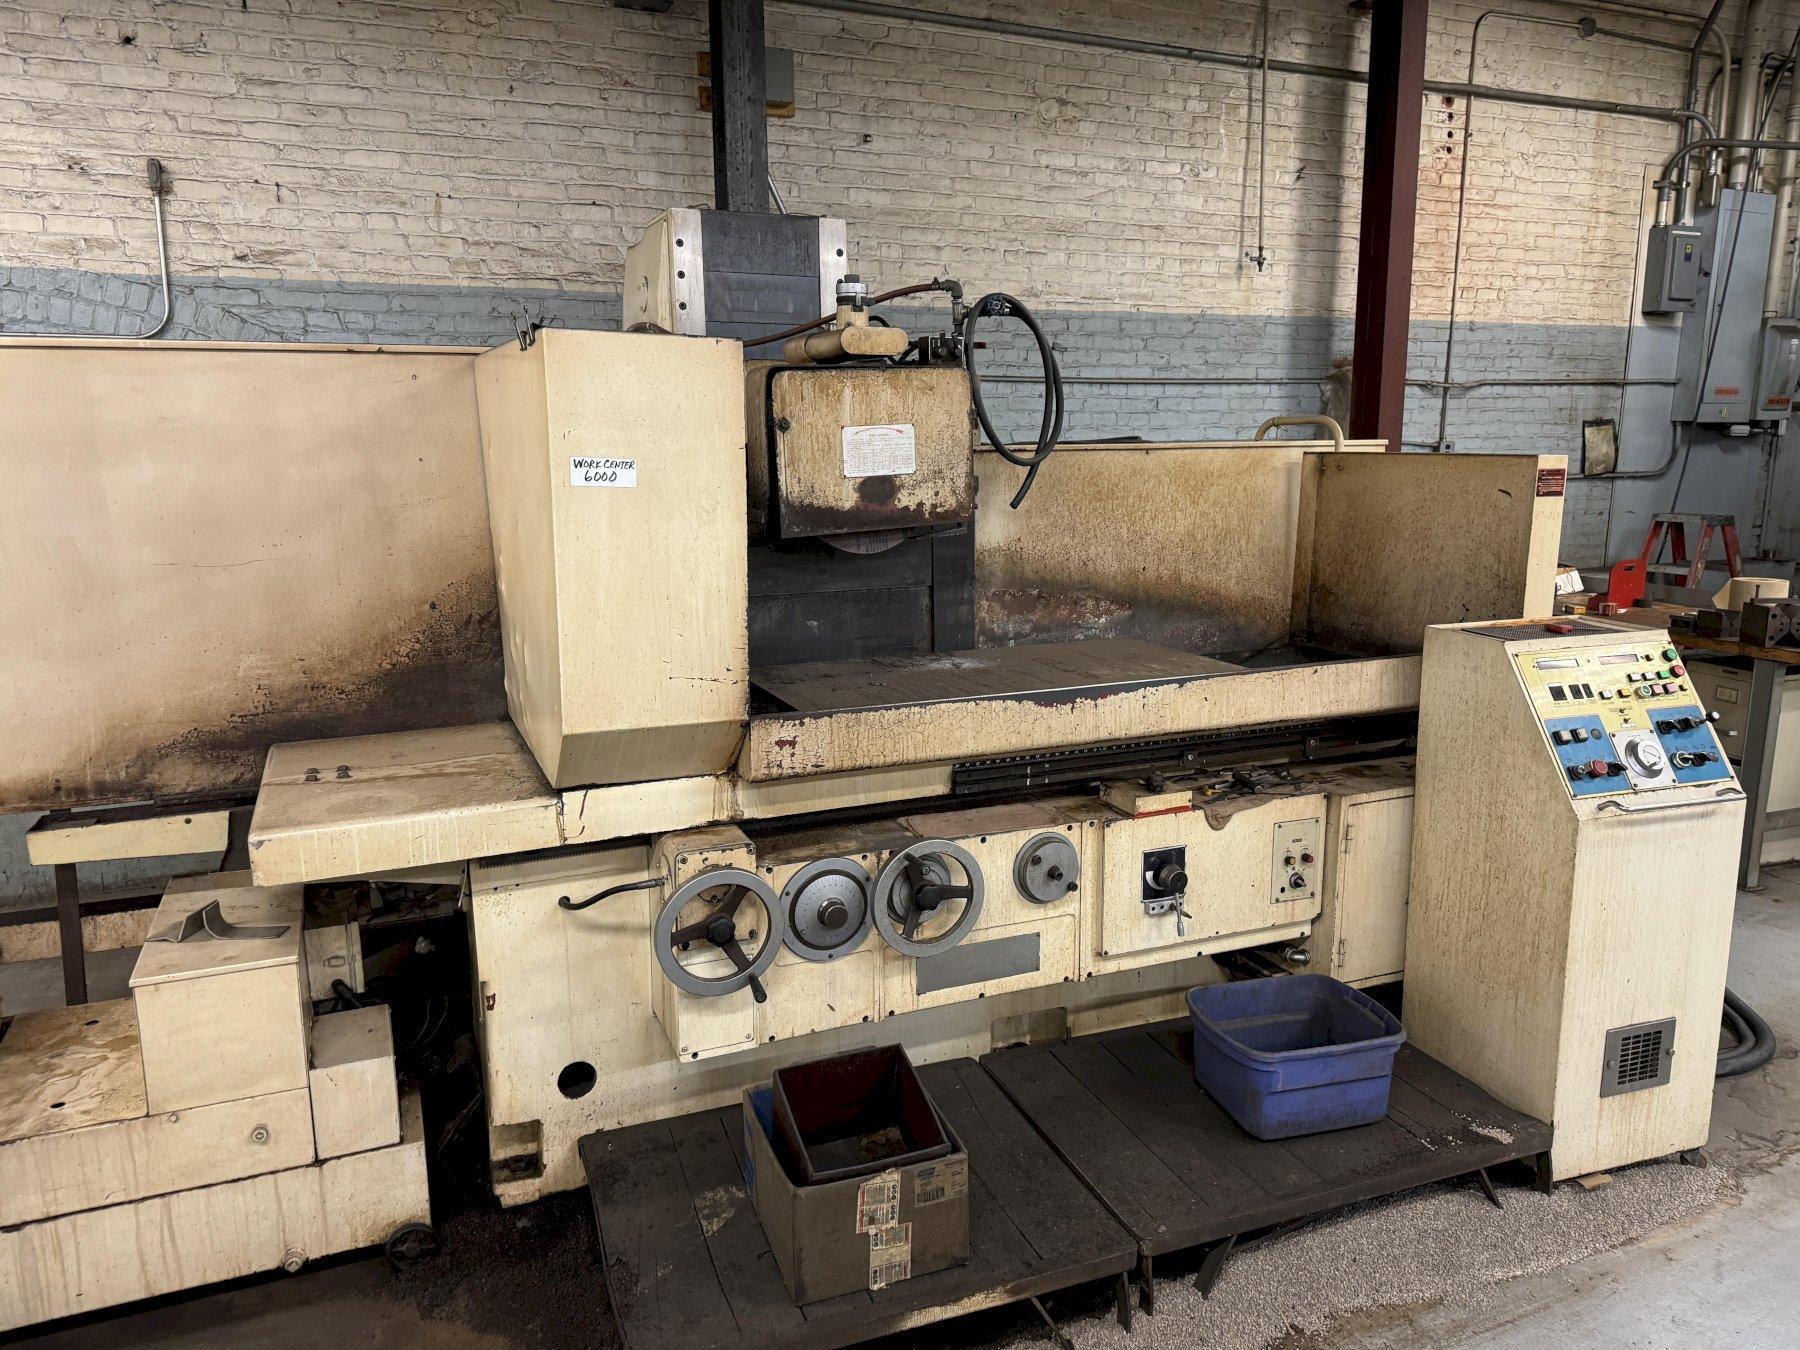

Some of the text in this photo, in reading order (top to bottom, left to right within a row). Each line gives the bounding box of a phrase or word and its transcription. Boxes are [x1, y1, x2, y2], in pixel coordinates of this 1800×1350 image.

[573, 459, 635, 470] WORK CENTER
[584, 470, 617, 482] 6000
